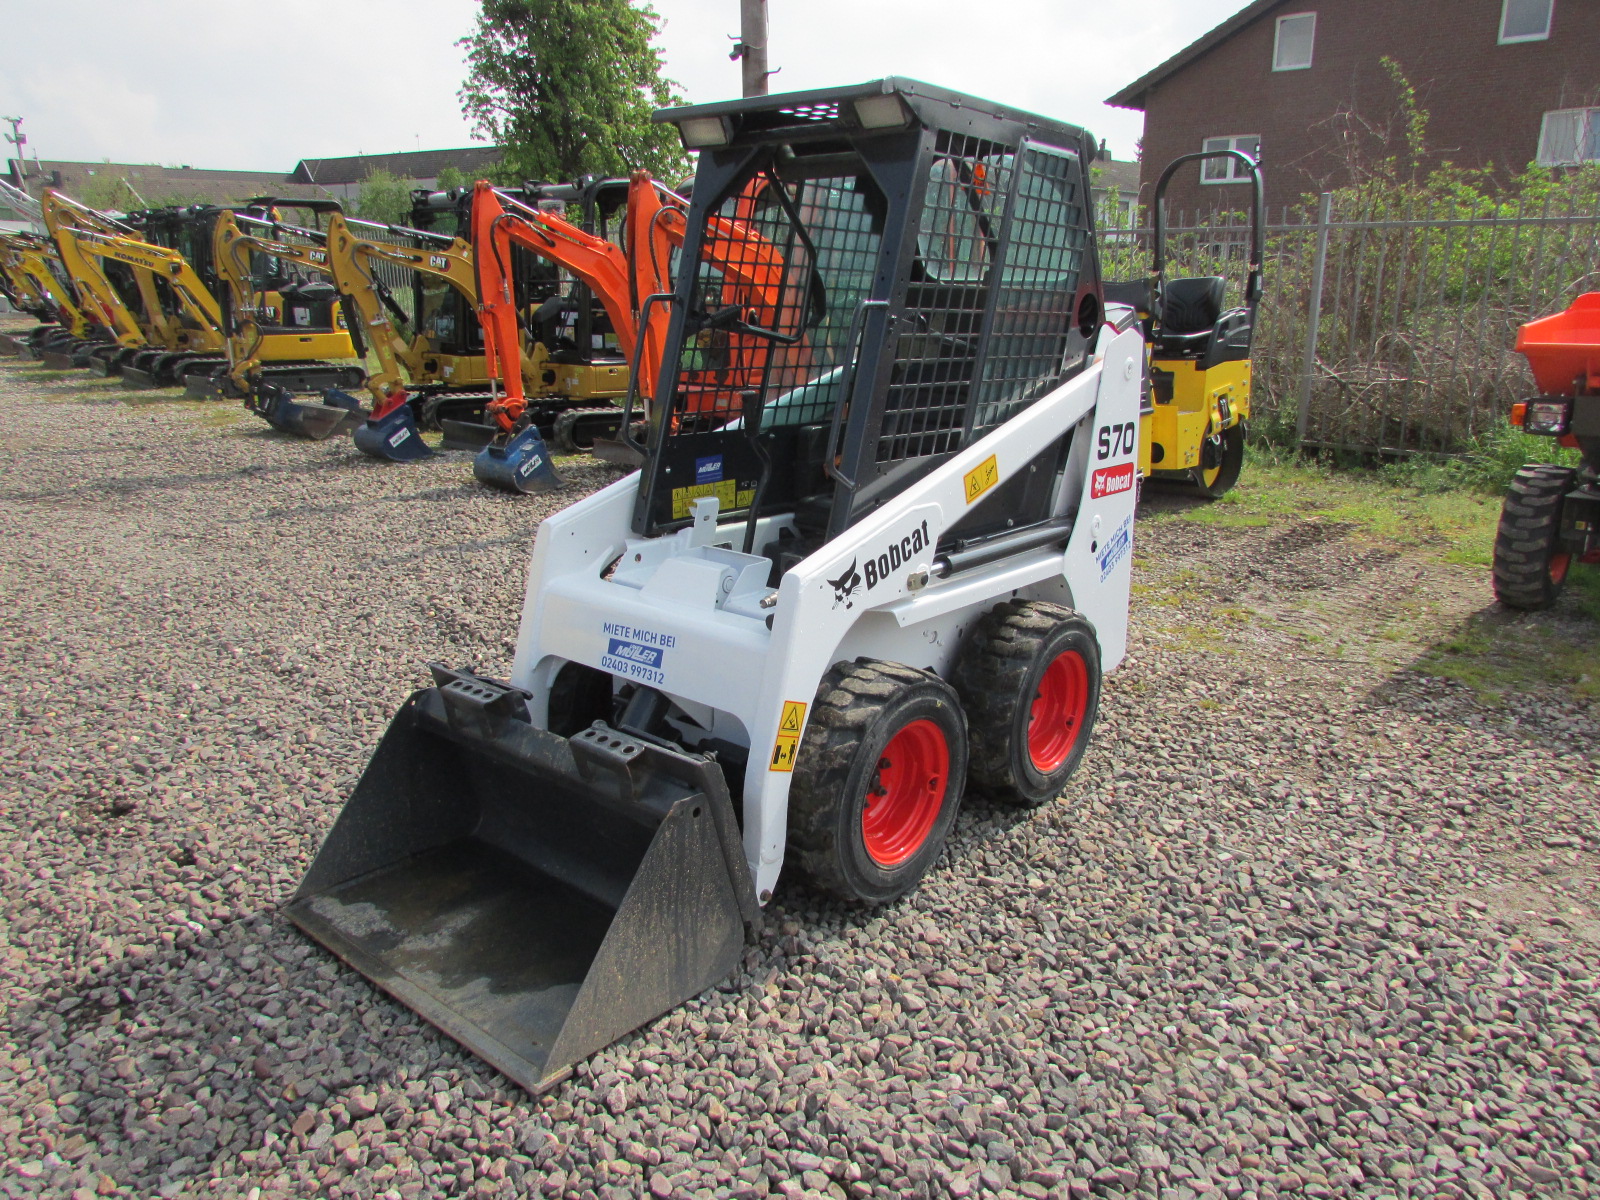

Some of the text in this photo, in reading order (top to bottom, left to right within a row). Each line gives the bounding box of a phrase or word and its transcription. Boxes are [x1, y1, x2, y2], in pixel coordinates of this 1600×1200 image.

[114, 251, 155, 267] KOMATSU
[309, 250, 326, 263] CAT
[429, 255, 447, 268] CAT
[1097, 421, 1135, 461] S70
[1105, 471, 1131, 493] Bobcat
[1095, 540, 1111, 564] MIETE
[1110, 524, 1123, 545] MICH
[1123, 513, 1132, 528] BEI
[863, 519, 930, 591] Bobcat
[603, 622, 631, 638] MIETE
[632, 628, 658, 644] MICH
[659, 634, 676, 648] BEI
[601, 655, 629, 673] 02403
[630, 664, 665, 685] 997312
